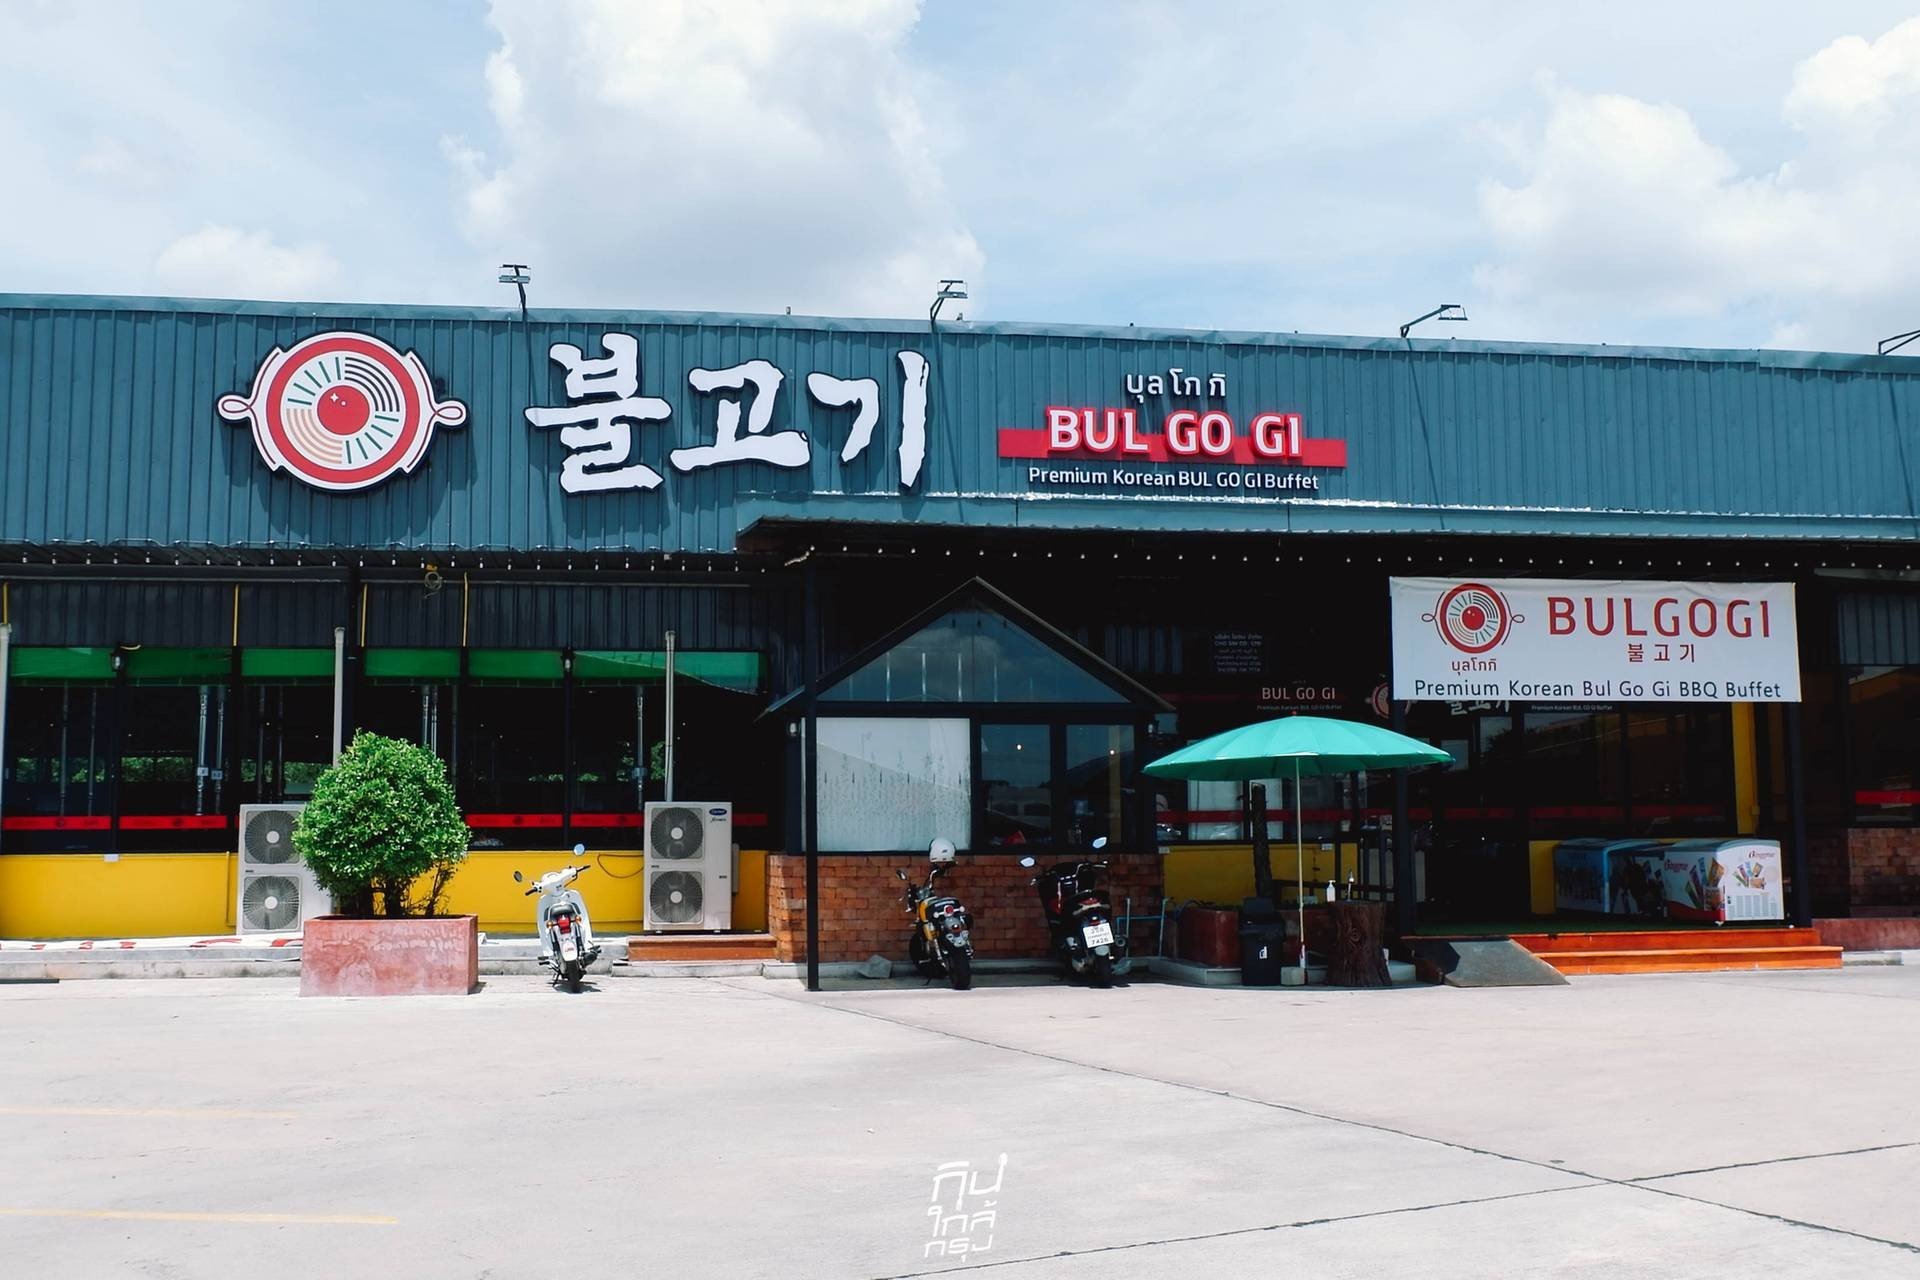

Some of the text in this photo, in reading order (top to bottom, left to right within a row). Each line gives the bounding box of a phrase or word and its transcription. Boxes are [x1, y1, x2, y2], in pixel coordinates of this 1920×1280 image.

[525, 333, 930, 493] 불고기
[1047, 407, 1301, 456] BUL GO GI
[1029, 467, 1319, 489] Premium Korean BUL GO GI Buffet
[1548, 596, 1770, 638] BULGOGI
[1627, 642, 1696, 664] 불고기
[1451, 656, 1497, 675] บุลโกกิ
[1262, 687, 1336, 700] BUL GO GI
[1415, 679, 1781, 700] Premium Korean Bul Go Gi BBQ Buffet
